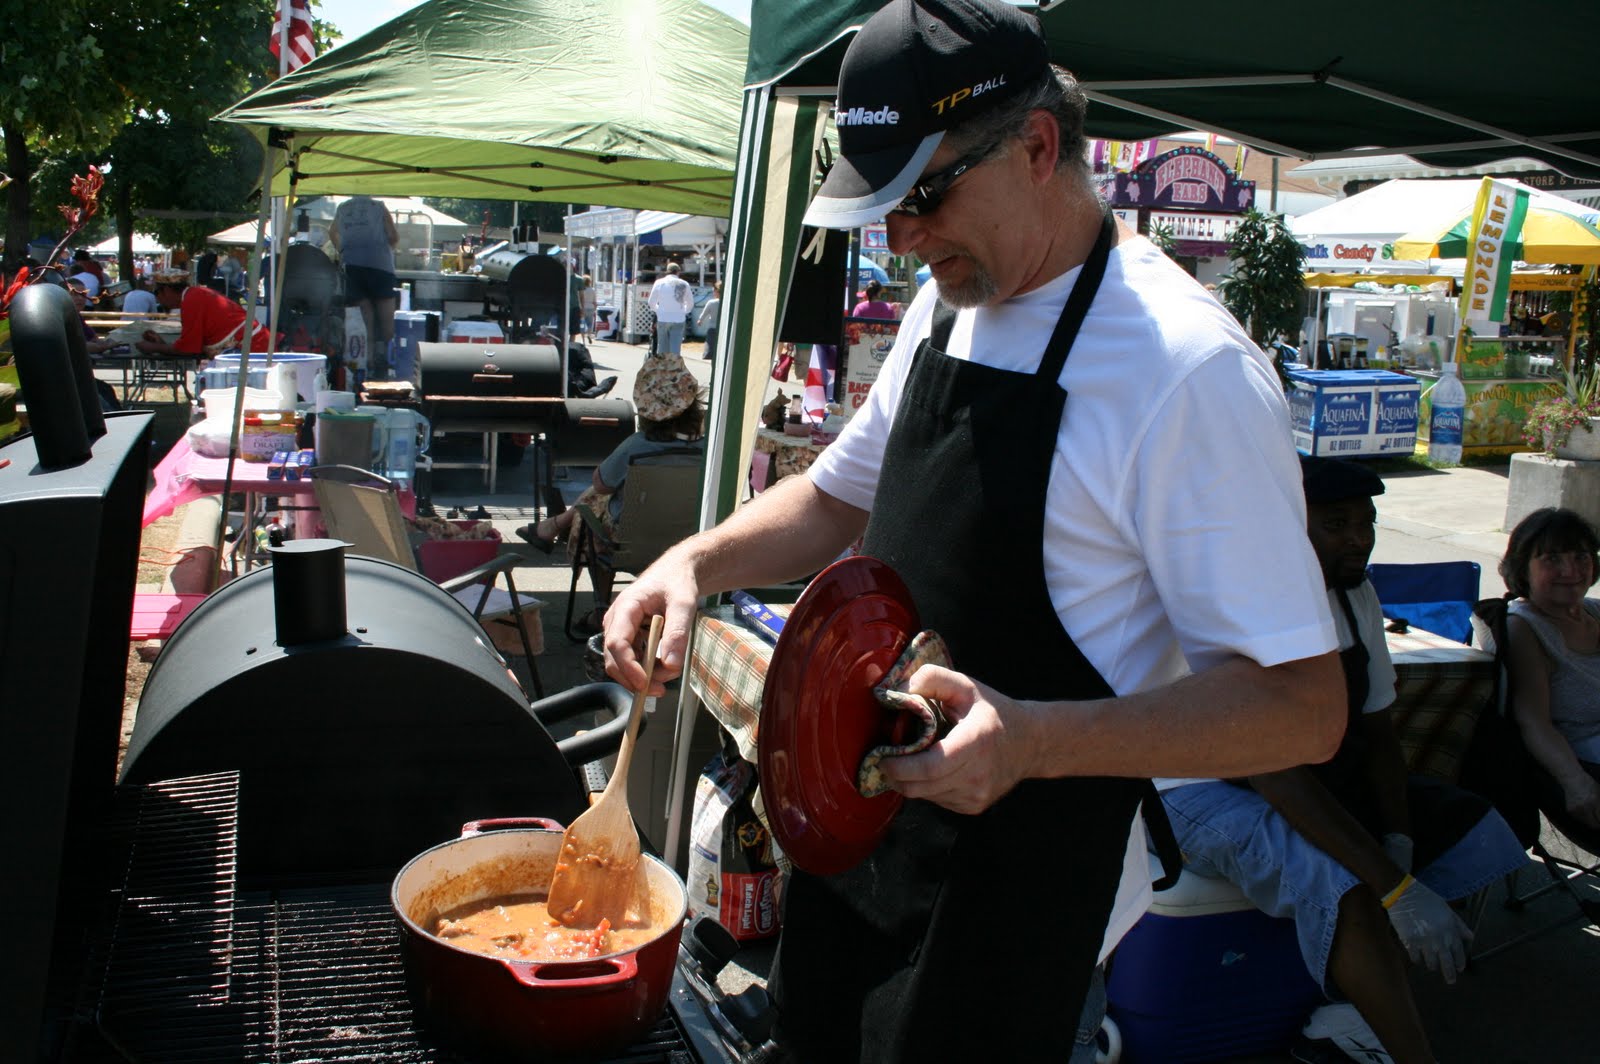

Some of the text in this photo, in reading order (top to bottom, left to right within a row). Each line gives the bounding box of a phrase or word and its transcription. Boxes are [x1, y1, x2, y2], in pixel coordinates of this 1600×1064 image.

[931, 73, 1007, 115] TP BALL
[1154, 154, 1226, 204] ELEPHANT
[1523, 175, 1555, 186] STORE
[1172, 182, 1208, 203] EARS
[1333, 243, 1377, 263] Candy
[1472, 195, 1507, 310] LEMONADE
[1320, 402, 1366, 425] AQUAFINA
[1376, 400, 1418, 424] AQUAFINA
[1432, 414, 1461, 431] AQUAFINA
[1338, 439, 1362, 451] BOTTLES
[744, 883, 754, 909] Match
